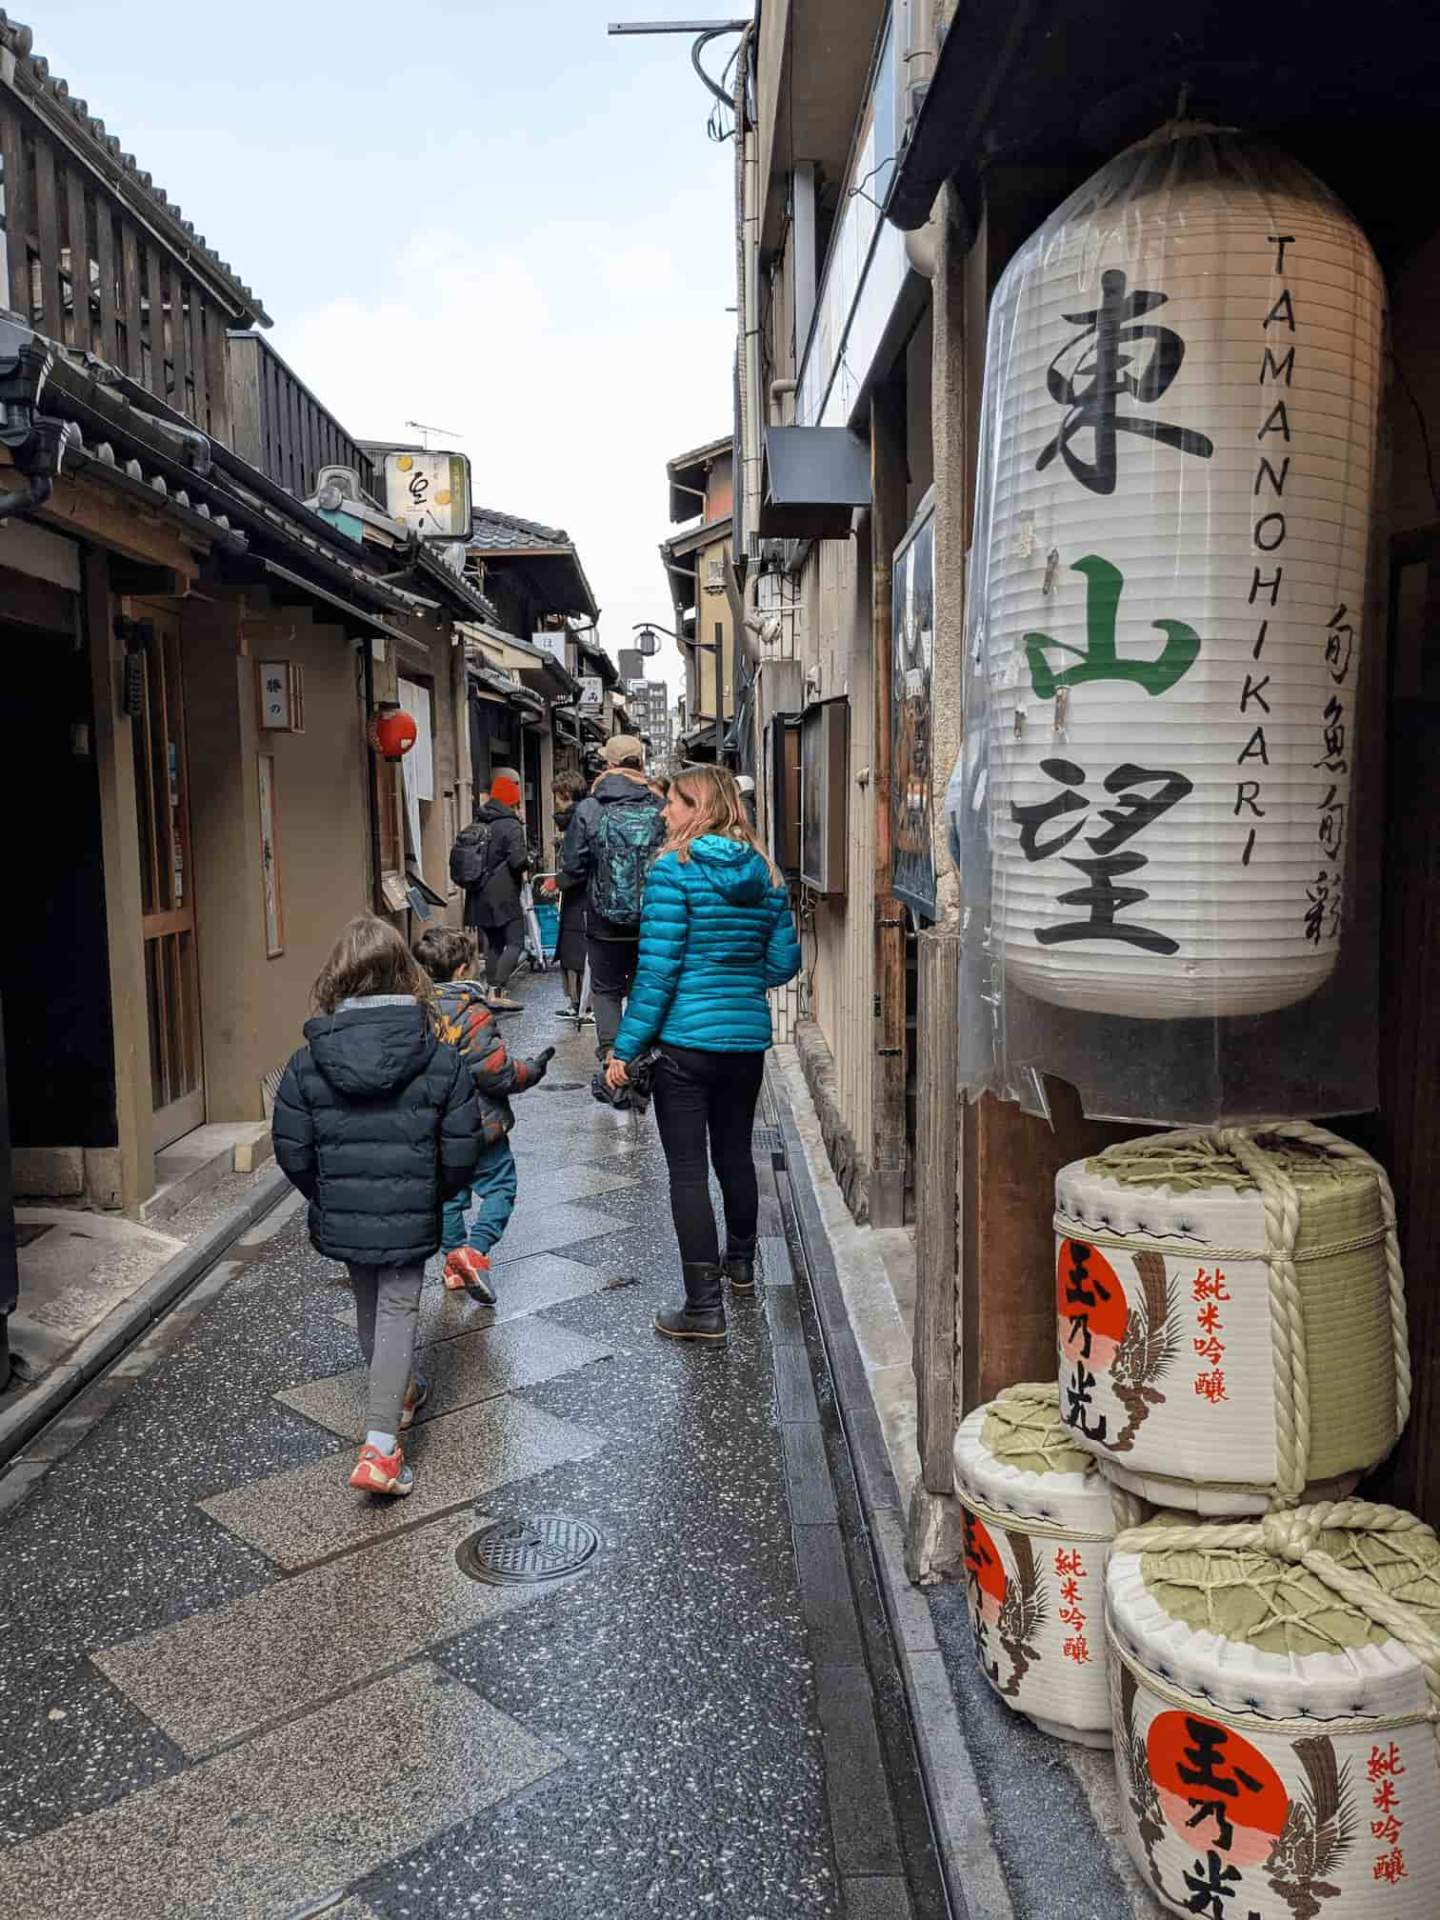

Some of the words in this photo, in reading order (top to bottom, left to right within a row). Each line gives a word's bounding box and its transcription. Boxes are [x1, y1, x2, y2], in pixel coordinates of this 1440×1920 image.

[1011, 269, 1214, 955] 東山望
[1234, 236, 1295, 866] TAMANOHIKARI
[1063, 1241, 1111, 1444] 玉乃光
